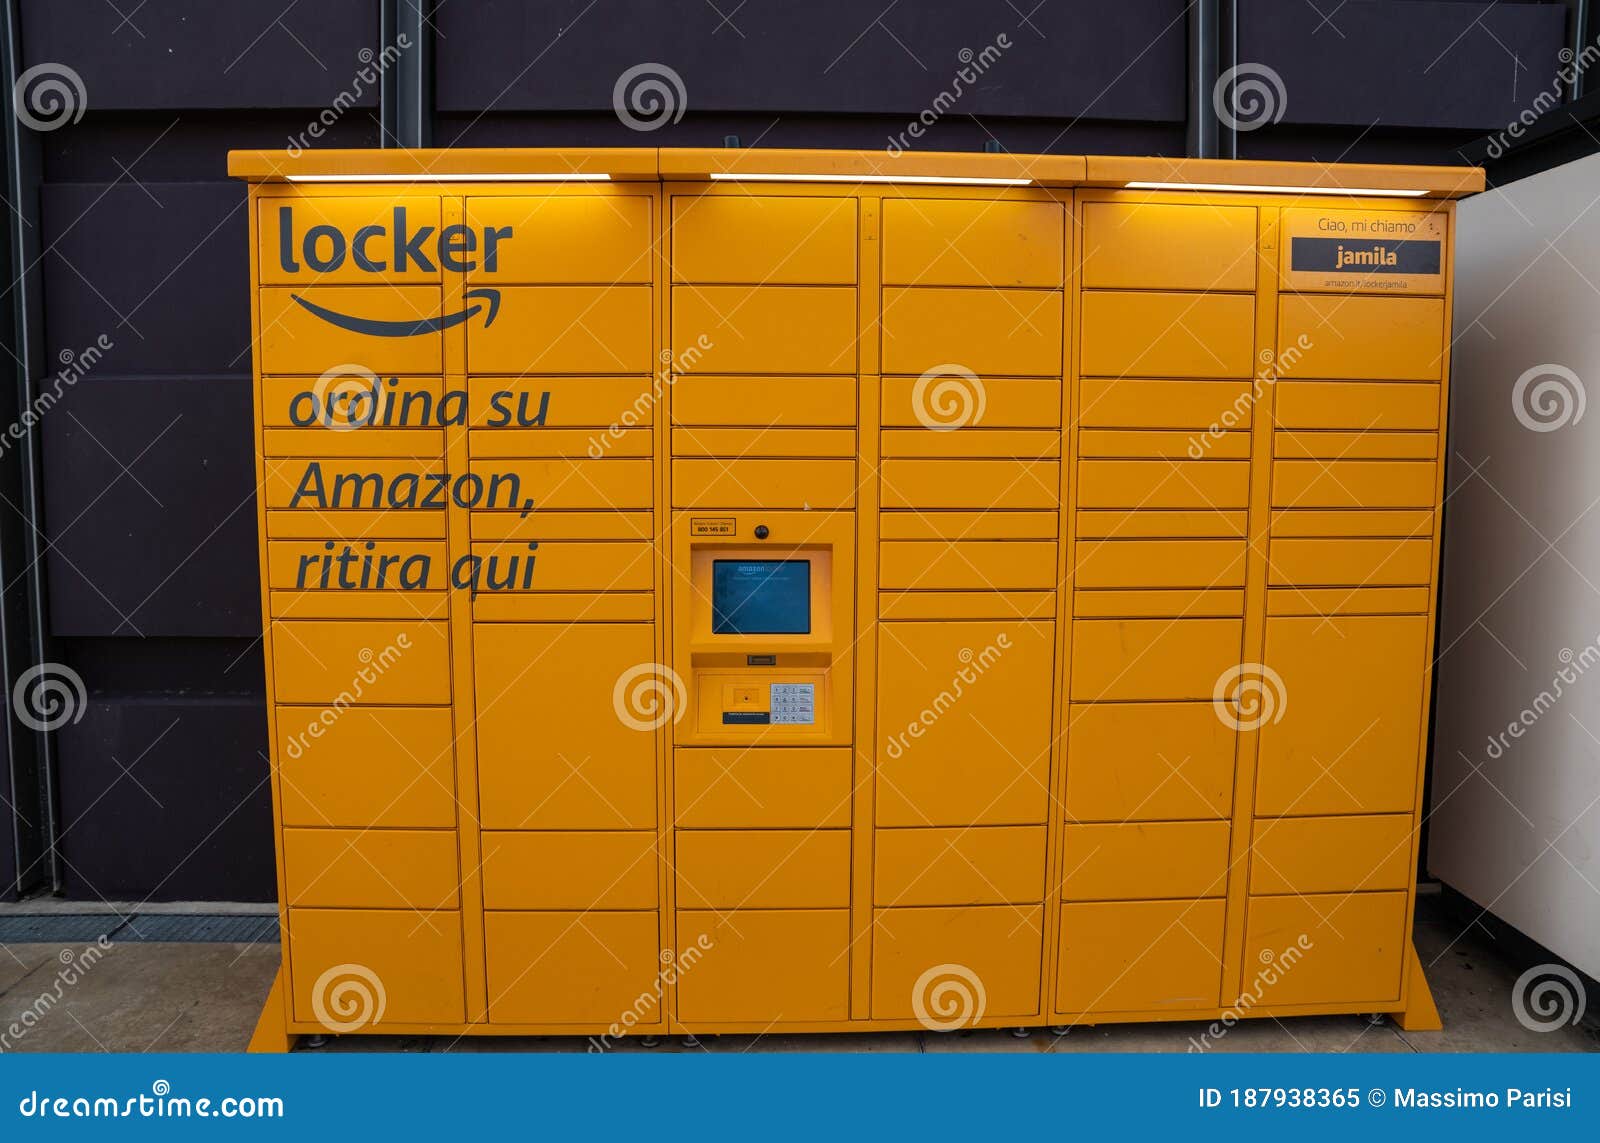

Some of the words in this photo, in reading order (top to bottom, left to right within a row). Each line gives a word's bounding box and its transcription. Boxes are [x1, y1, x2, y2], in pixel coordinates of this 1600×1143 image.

[279, 206, 513, 273] locker
[1318, 217, 1348, 233] Ciao,
[1351, 221, 1368, 232] mi
[1370, 219, 1416, 233] chiamo
[1335, 244, 1398, 269] jamila
[289, 376, 469, 427] ordina
[487, 390, 551, 427] su
[289, 462, 535, 519] Amazon,
[296, 541, 431, 590] ritira
[451, 541, 538, 603] qui
